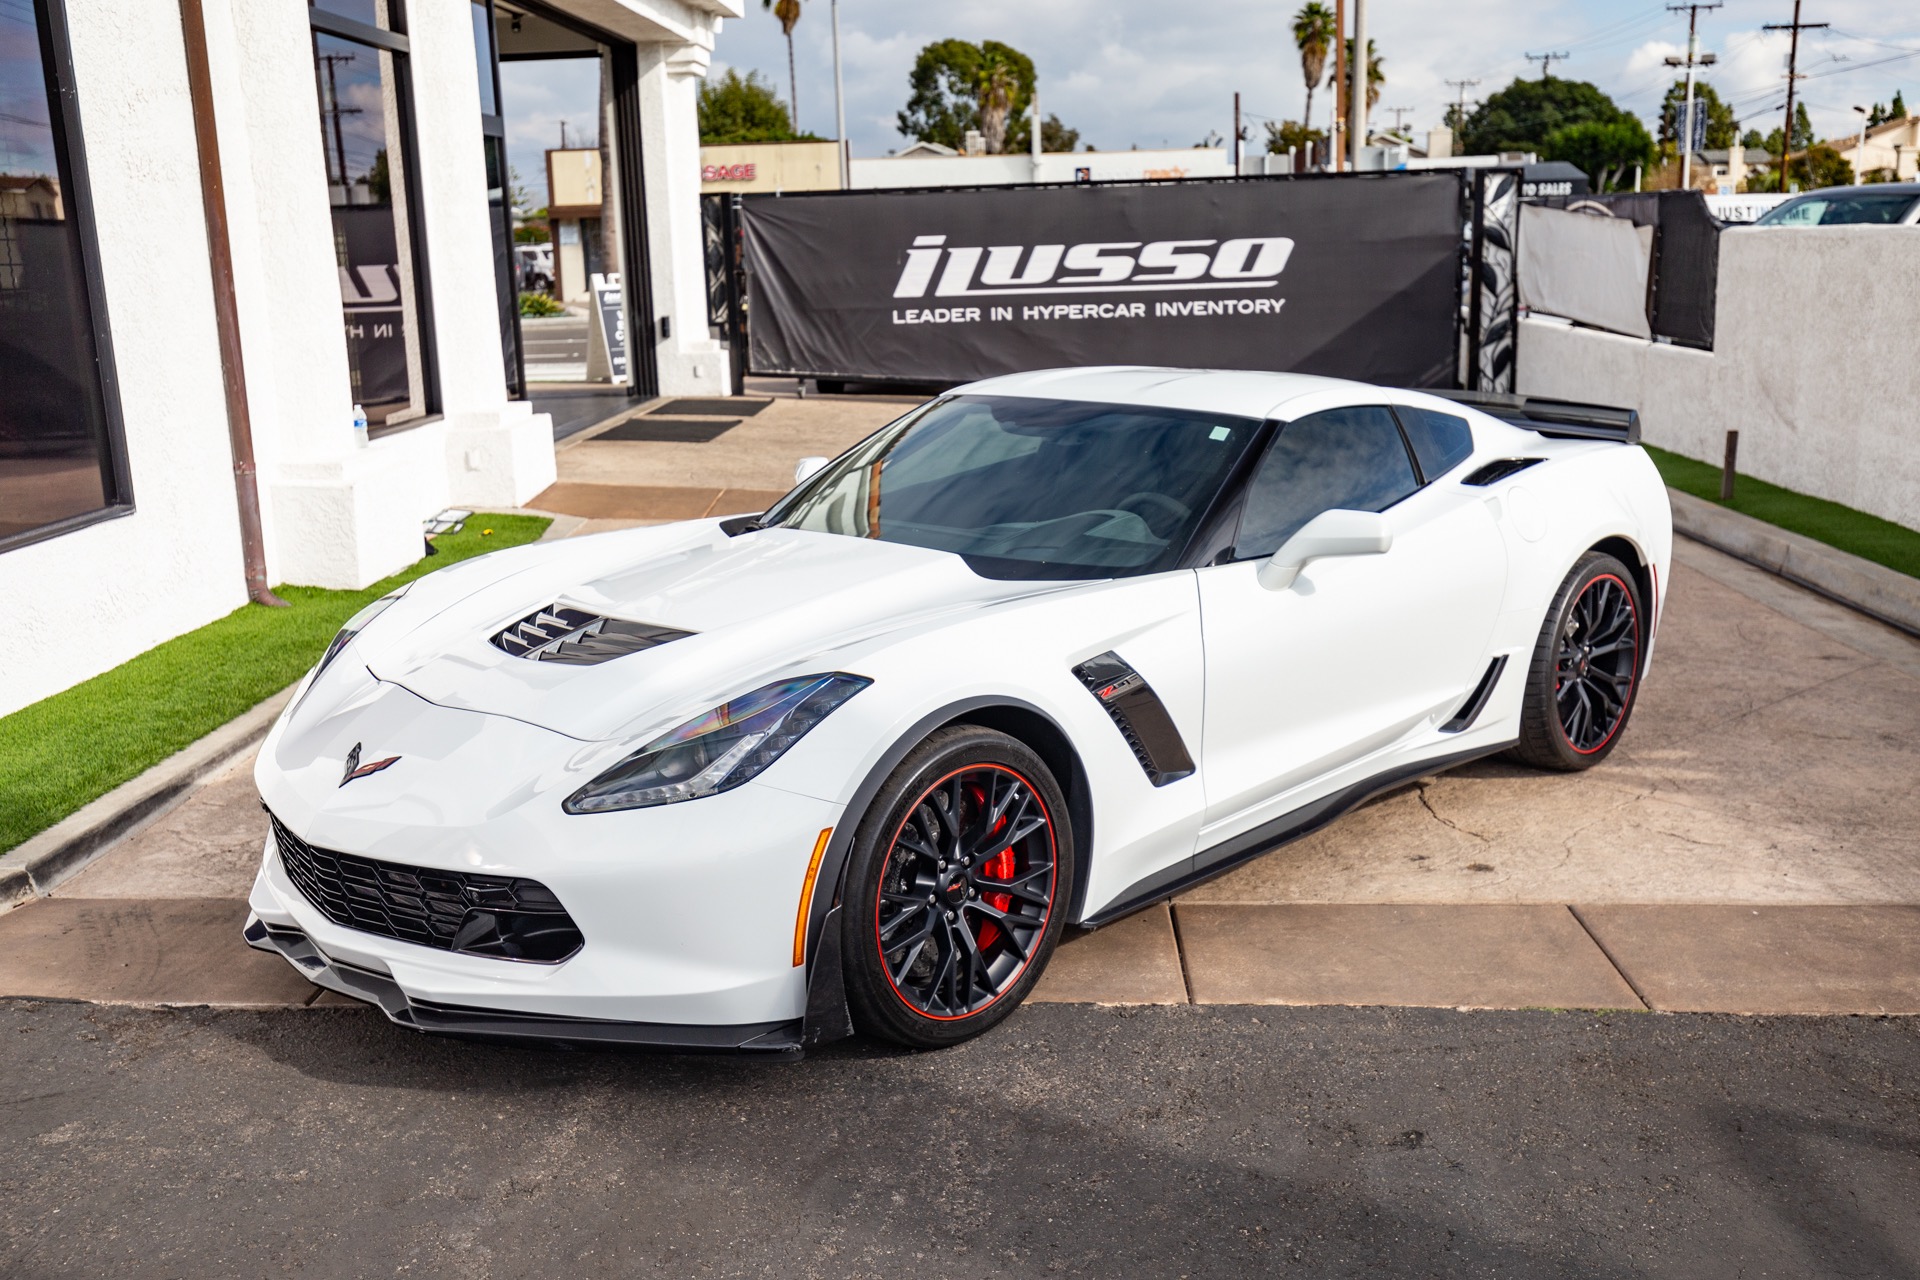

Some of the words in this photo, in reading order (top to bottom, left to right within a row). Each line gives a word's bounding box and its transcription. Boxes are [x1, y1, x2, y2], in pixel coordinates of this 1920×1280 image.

[1538, 182, 1572, 196] SALES
[893, 307, 981, 324] LEADER
[990, 306, 1013, 321] IN
[1023, 302, 1146, 320] HYPERCAR
[1155, 298, 1286, 316] INVENTORY
